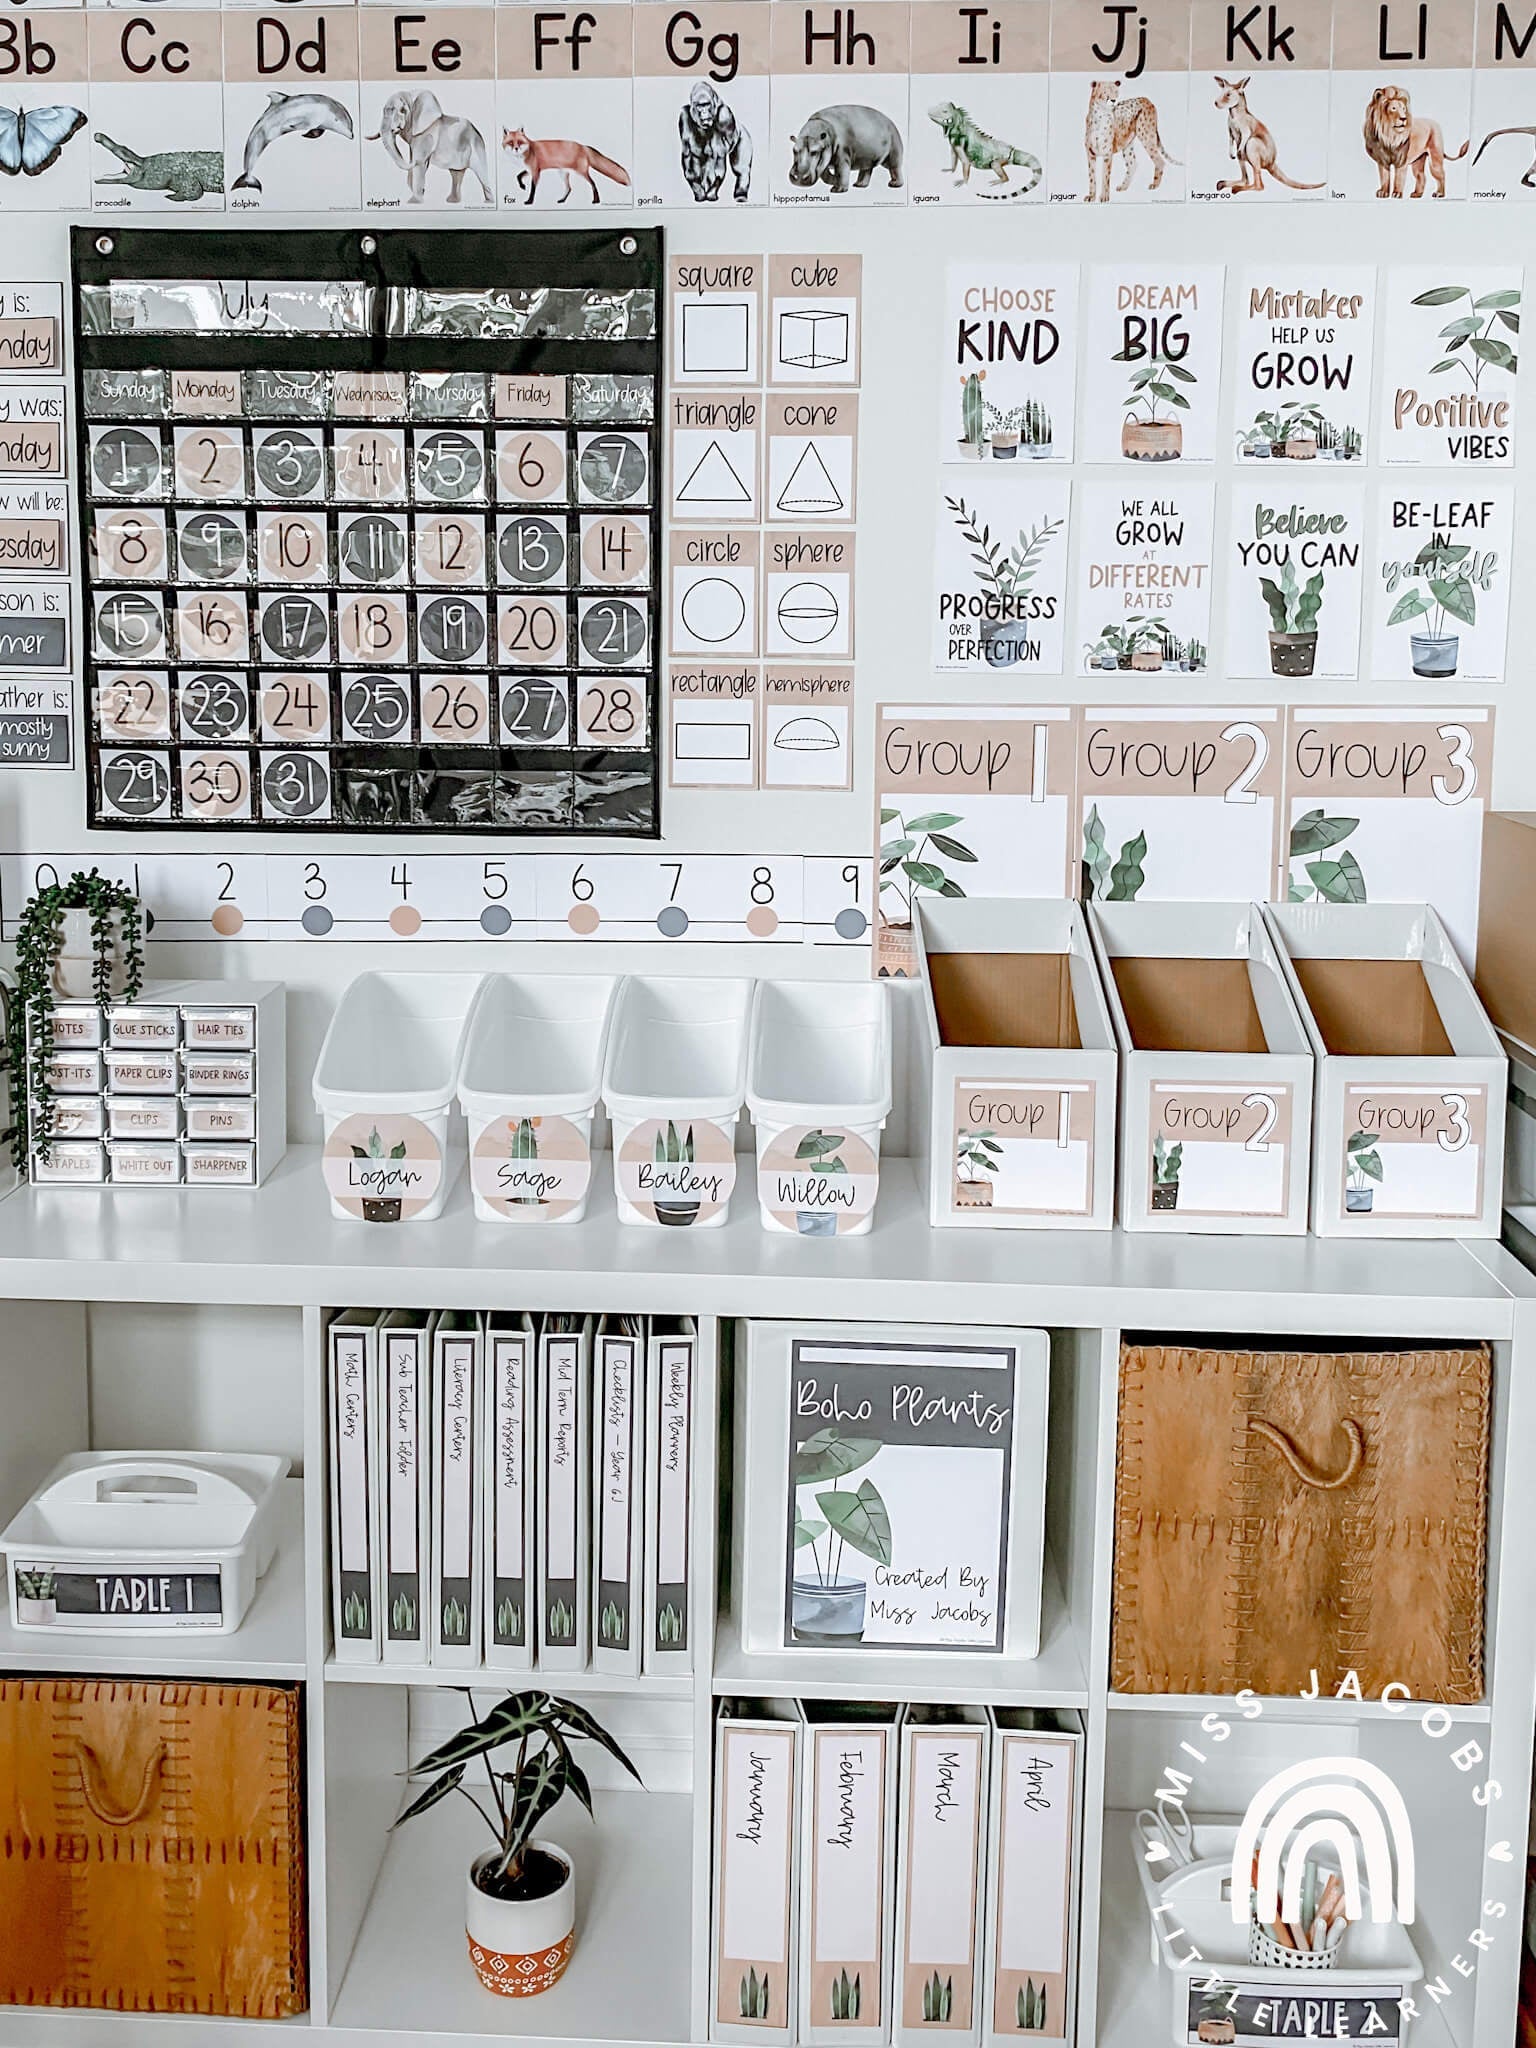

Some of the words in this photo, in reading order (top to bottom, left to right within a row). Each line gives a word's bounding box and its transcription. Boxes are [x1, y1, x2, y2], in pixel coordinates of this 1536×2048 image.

[0, 18, 56, 75] Bb
[121, 18, 190, 73] Cc
[257, 17, 326, 74] Dd
[394, 15, 461, 72] Ee
[534, 13, 597, 70] Ff
[665, 11, 739, 82] Gg
[805, 9, 875, 65] Hh
[958, 8, 1001, 64] Ii
[1092, 6, 1147, 78] Jj
[1226, 5, 1295, 61] Kk
[1379, 3, 1427, 60] Ll
[95, 199, 131, 207] crocodile
[231, 200, 260, 209] dolphin
[367, 199, 401, 208] elephant
[504, 195, 516, 204] fox
[638, 196, 663, 206] gorilla
[774, 195, 830, 205] hippopotamus
[913, 195, 940, 203] iguana
[1050, 192, 1077, 201] jaguar
[1191, 190, 1231, 201] kangaroo
[1331, 191, 1346, 199] lion
[1474, 191, 1506, 200] monkey
[678, 266, 753, 296] square
[791, 259, 838, 287] cube
[13, 293, 30, 312] is:
[964, 286, 1056, 313] CHOOSE
[1117, 284, 1198, 311] DREAM
[1249, 286, 1364, 320] Mistakes
[957, 318, 1060, 365] KIND
[1123, 313, 1190, 361] BIG
[1271, 326, 1309, 344] HELP
[1315, 327, 1336, 344] US
[1251, 351, 1353, 391] GROW
[101, 380, 155, 402] Sunday
[176, 380, 235, 402] Monday
[508, 383, 551, 407] Friday
[19, 398, 62, 417] was:
[674, 396, 755, 432] triangle
[784, 406, 837, 426] cone
[1394, 388, 1510, 430] Positive
[1447, 434, 1510, 460] VIBES
[199, 438, 221, 483] 2
[276, 440, 301, 485] 3
[436, 440, 466, 486] 5
[519, 442, 544, 487] 6
[17, 490, 40, 511] will
[45, 491, 64, 511] be:
[1121, 500, 1144, 517] WE
[1149, 500, 1179, 517] ALL
[1392, 501, 1495, 529] BE-LEAF
[1115, 520, 1184, 546] GROW
[1255, 503, 1348, 540] Believe
[518, 526, 549, 571] 13
[601, 526, 631, 570] 14
[686, 534, 741, 562] circle
[773, 536, 844, 570] sphere
[1142, 550, 1156, 561] AT
[1237, 542, 1290, 567] YOU
[1301, 541, 1359, 568] CAN
[1431, 532, 1451, 551] IN
[1089, 563, 1209, 589] DIFFERENT
[939, 593, 1057, 621] PROGRESS
[1124, 592, 1174, 609] RATES
[113, 602, 149, 646] 15
[280, 603, 313, 648] 17
[442, 605, 466, 650] 19
[508, 606, 556, 650] 20
[597, 607, 629, 652] 21
[949, 623, 972, 636] OVER
[948, 639, 1041, 661] PERFECTION
[671, 669, 756, 699] rectangle
[766, 674, 850, 697] hemisphere
[190, 681, 239, 726] 23
[271, 683, 319, 727] 24
[351, 683, 402, 728] 25
[431, 685, 478, 729] 26
[510, 686, 557, 731] 27
[586, 688, 634, 732] 28
[0, 717, 53, 740] mostly
[2, 741, 50, 760] sunny
[885, 727, 1011, 791] Group
[1031, 724, 1048, 802] 1
[1088, 729, 1216, 792] Group
[1219, 721, 1269, 804] 2
[1296, 729, 1426, 793] Group
[1430, 723, 1477, 805] 3
[277, 761, 314, 805] 31
[217, 862, 236, 900] 2
[304, 863, 327, 900] 3
[391, 863, 413, 900] 4
[483, 862, 507, 899] 5
[572, 863, 594, 900] 6
[660, 863, 683, 901] 7
[750, 866, 774, 904] 8
[842, 865, 859, 903] 9
[113, 1024, 136, 1035] GLUE
[141, 1024, 175, 1036] STICKS
[198, 1024, 219, 1036] HAIR
[224, 1024, 244, 1036] TIES
[114, 1068, 142, 1079] PAPER
[146, 1069, 172, 1079] CLIPS
[189, 1069, 219, 1080] BINDER
[222, 1070, 249, 1080] RINGS
[130, 1114, 158, 1125] CLIPS
[210, 1115, 233, 1126] PINS
[968, 1094, 1044, 1134] Group
[1057, 1091, 1070, 1148] 1
[1164, 1098, 1241, 1138] Group
[1241, 1092, 1277, 1152] 2
[1358, 1100, 1435, 1138] Group
[1436, 1093, 1471, 1152] 3
[153, 1160, 173, 1171] OUT
[193, 1160, 247, 1171] SHARPENER
[349, 1162, 422, 1195] Logan
[497, 1164, 562, 1197] Sage
[638, 1163, 723, 1202] Bailey
[778, 1177, 855, 1206] Willow
[345, 1353, 359, 1387] Math
[398, 1353, 412, 1378] Sub
[557, 1359, 572, 1380] Mid
[448, 1359, 468, 1410] Literacy
[501, 1358, 520, 1411] Reading
[664, 1362, 685, 1409] Weekly
[344, 1393, 360, 1439] Centers
[398, 1384, 413, 1432] Teacher
[557, 1387, 572, 1416] Term
[796, 1379, 872, 1421] Boho
[891, 1384, 1010, 1435] Plants
[450, 1416, 468, 1462] Centers
[553, 1424, 572, 1466] Reports
[665, 1415, 685, 1472] Planners
[396, 1440, 413, 1477] Folder
[610, 1451, 625, 1481] Year
[95, 1577, 171, 1613] TABLE
[186, 1577, 193, 1613] 1
[874, 1565, 948, 1590] Created
[959, 1566, 990, 1598] By
[870, 1600, 917, 1625] Miss
[931, 1601, 992, 1626] Jacobs
[735, 1751, 772, 1845] January
[934, 1752, 961, 1822] March
[1020, 1756, 1054, 1812] April
[827, 1750, 864, 1849] February
